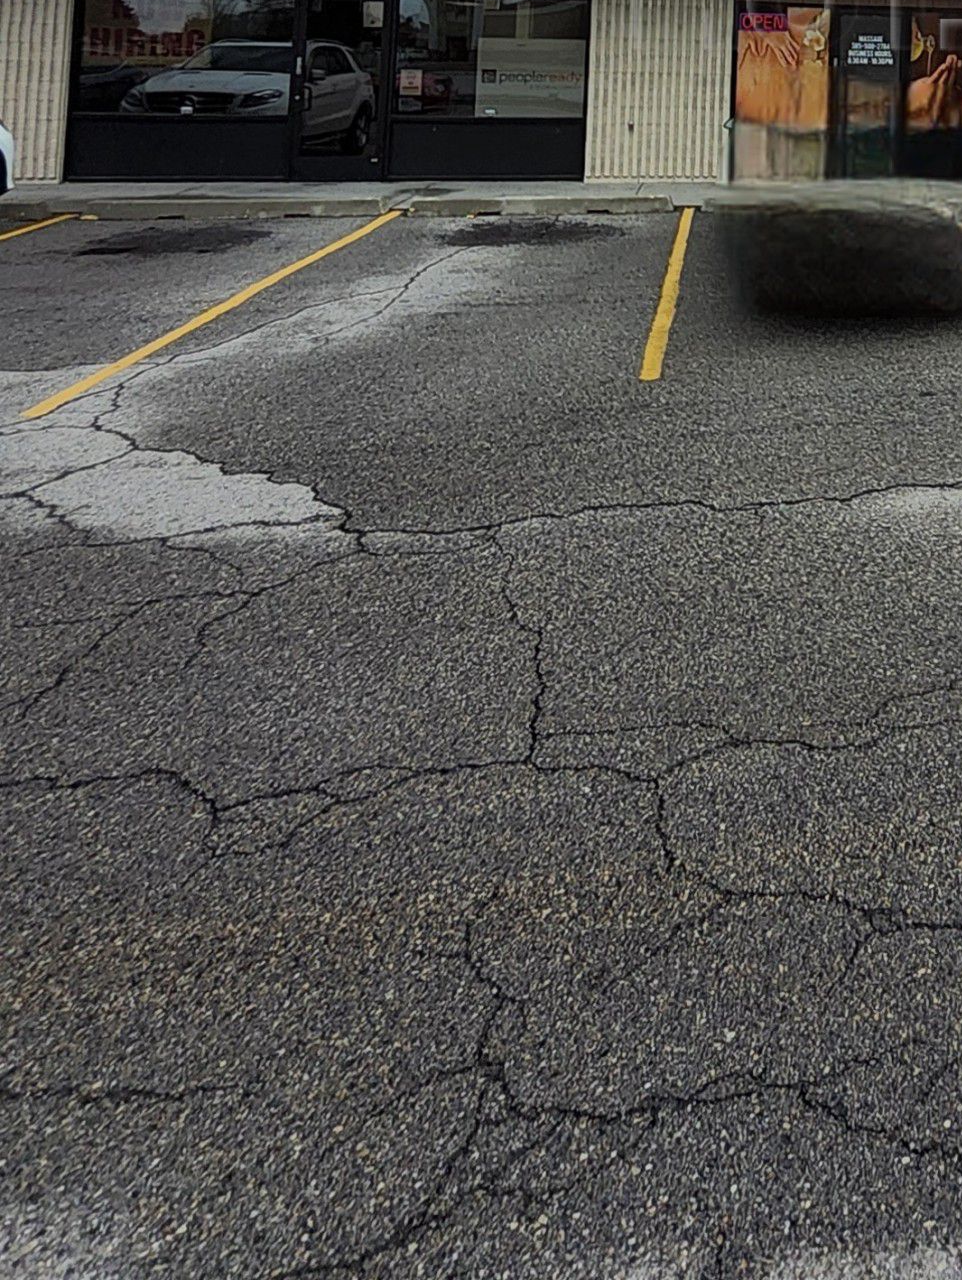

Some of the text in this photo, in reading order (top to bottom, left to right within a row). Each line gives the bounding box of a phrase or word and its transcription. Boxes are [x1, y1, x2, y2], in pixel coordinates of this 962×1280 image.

[742, 15, 784, 30] OPEN
[89, 26, 206, 57] HIRING
[499, 71, 582, 85] peopleready
